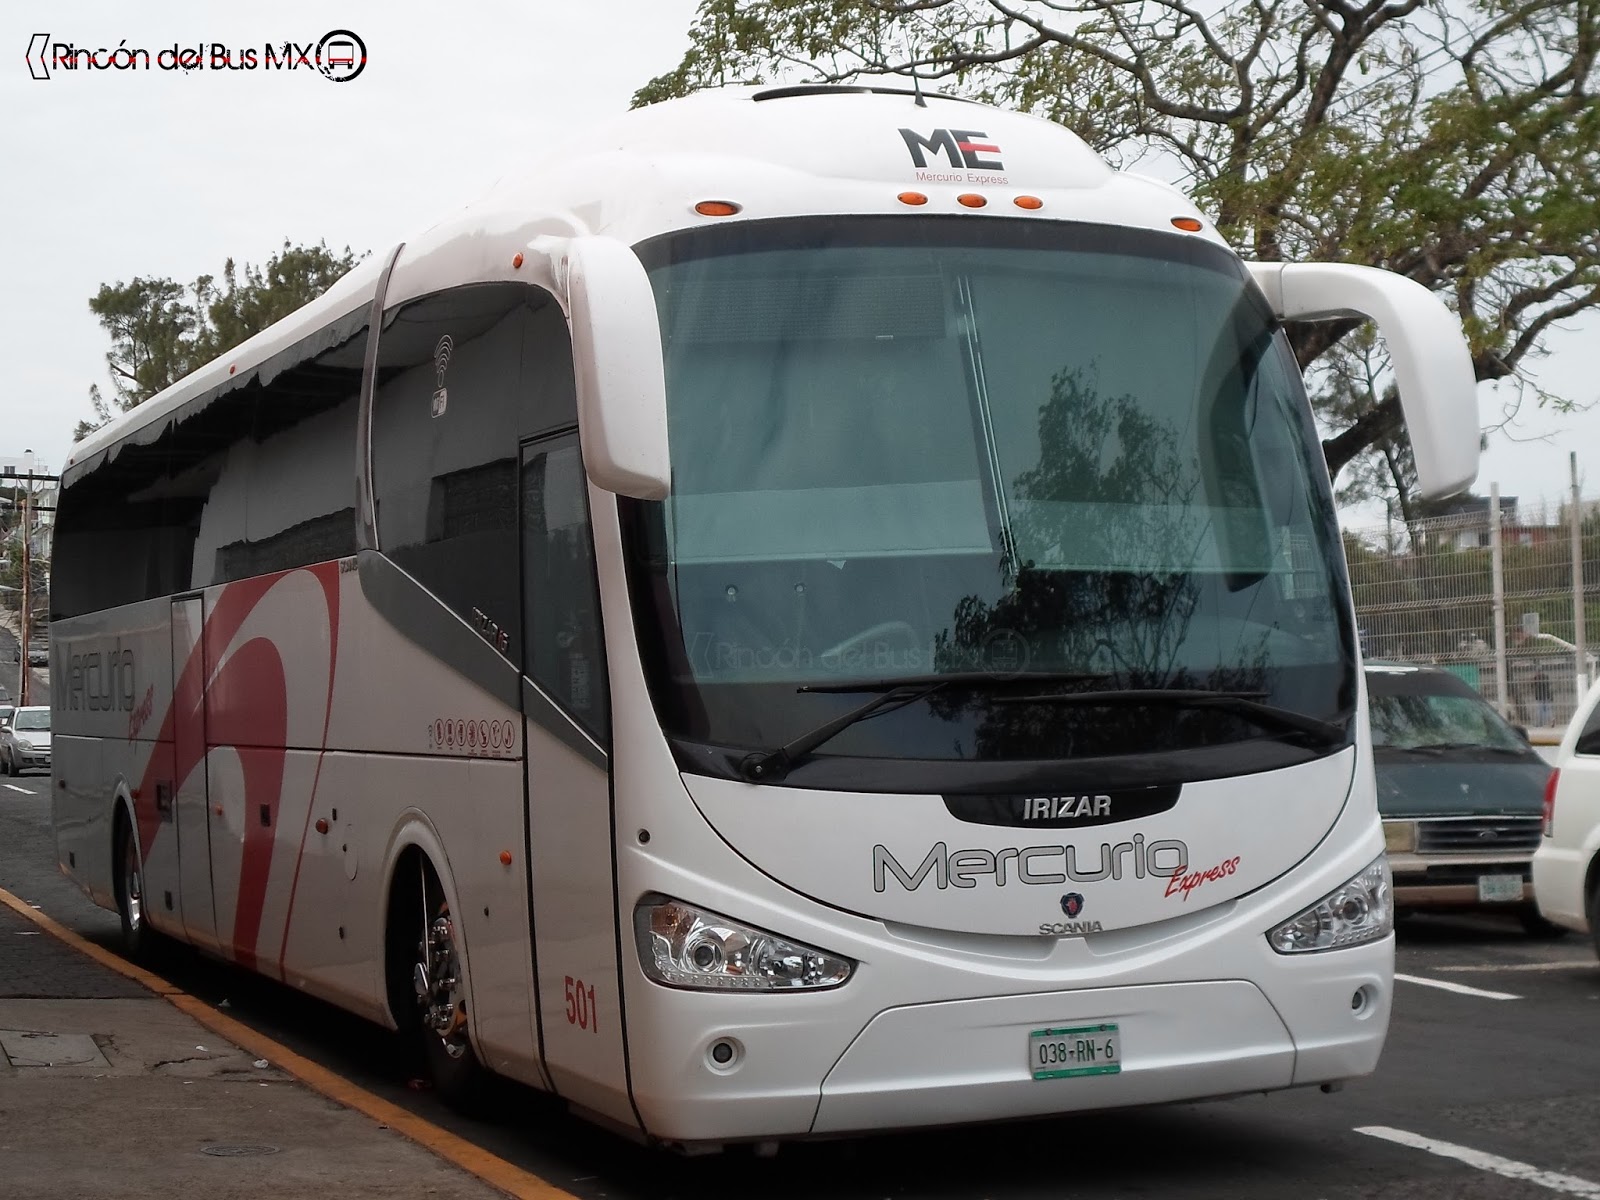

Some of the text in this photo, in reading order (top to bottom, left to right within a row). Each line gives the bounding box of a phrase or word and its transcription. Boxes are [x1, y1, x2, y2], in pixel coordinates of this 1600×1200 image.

[897, 128, 1005, 171] ME
[915, 171, 1009, 186] Mercurio Express
[1023, 794, 1112, 821] IRIZAR
[872, 832, 1189, 893] Mercurio
[1163, 855, 1241, 902] Express
[1039, 920, 1103, 935] SCANIA
[564, 975, 598, 1034] 501
[1039, 1038, 1114, 1065] 038-RN-6
